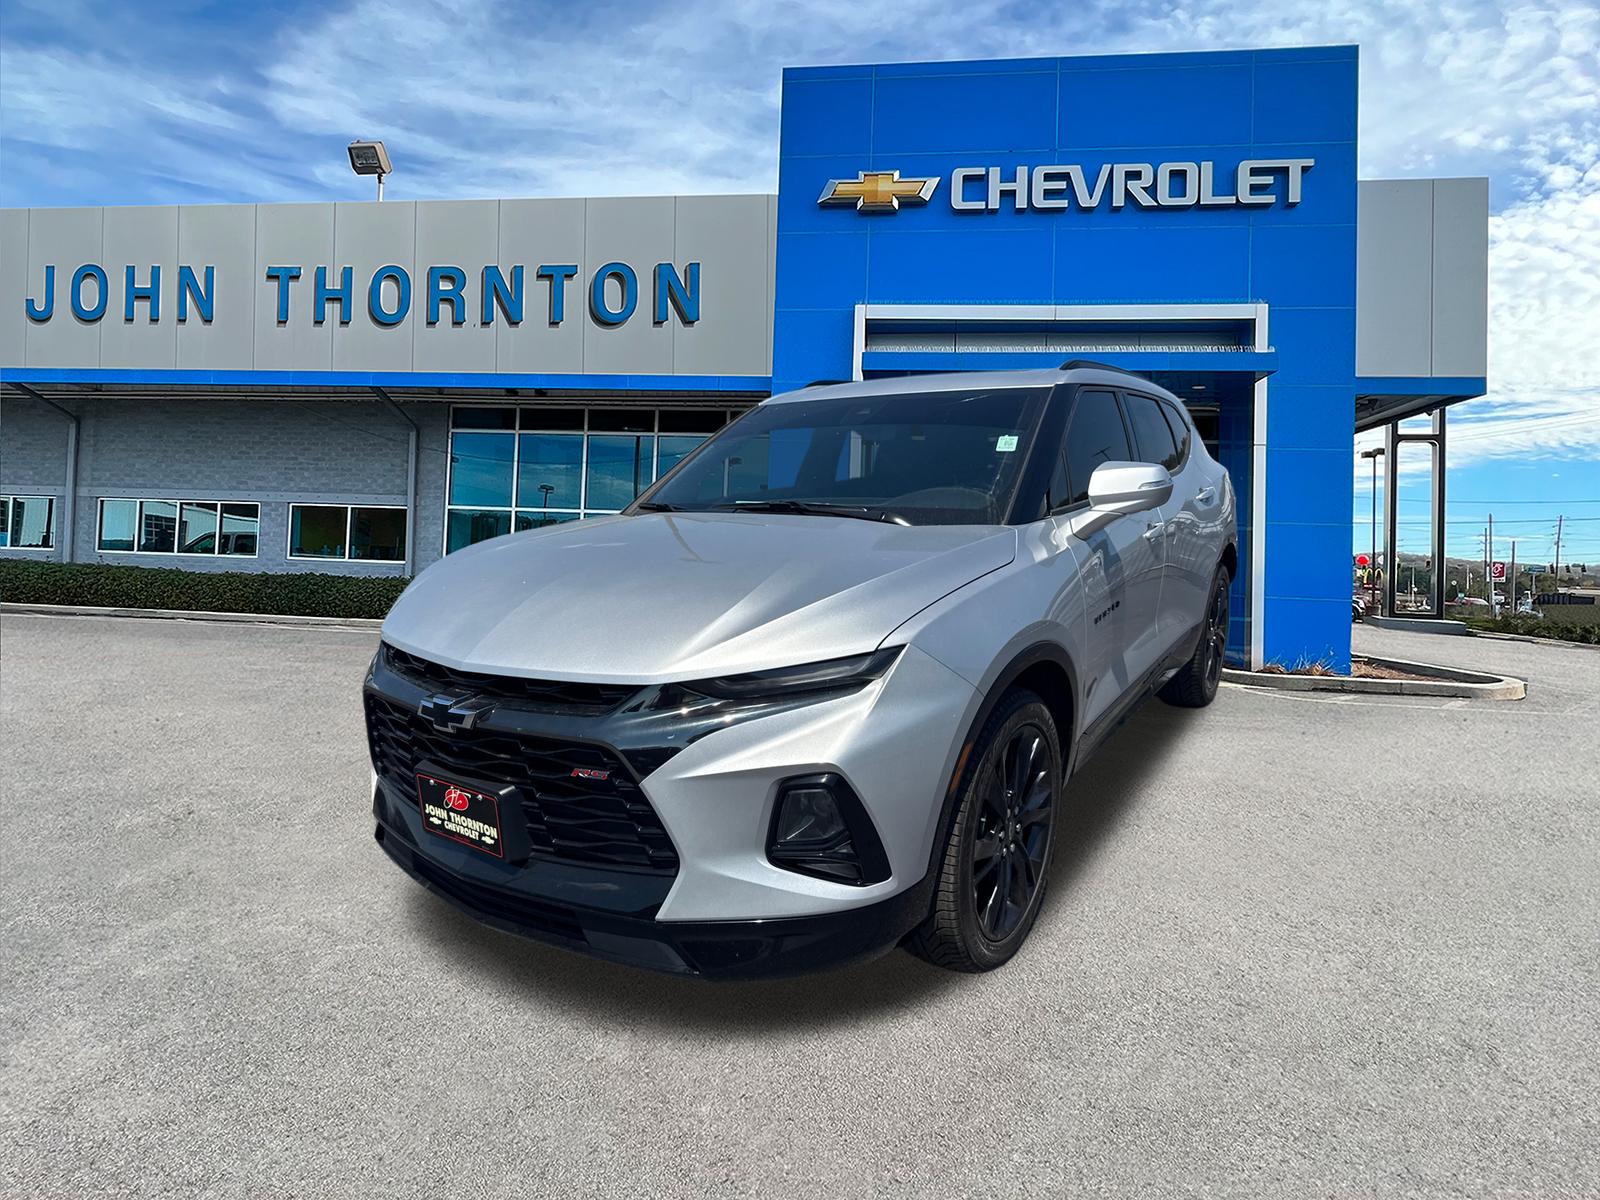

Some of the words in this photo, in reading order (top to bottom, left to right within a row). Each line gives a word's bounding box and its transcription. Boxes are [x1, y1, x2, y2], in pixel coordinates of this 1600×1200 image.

[950, 158, 1316, 214] CHEVROLET
[25, 263, 216, 323] JOHN
[266, 261, 702, 327] THORNTON
[425, 803, 449, 821] JOHN
[449, 811, 498, 840] THORNTON
[443, 820, 480, 840] CHEVROLET
